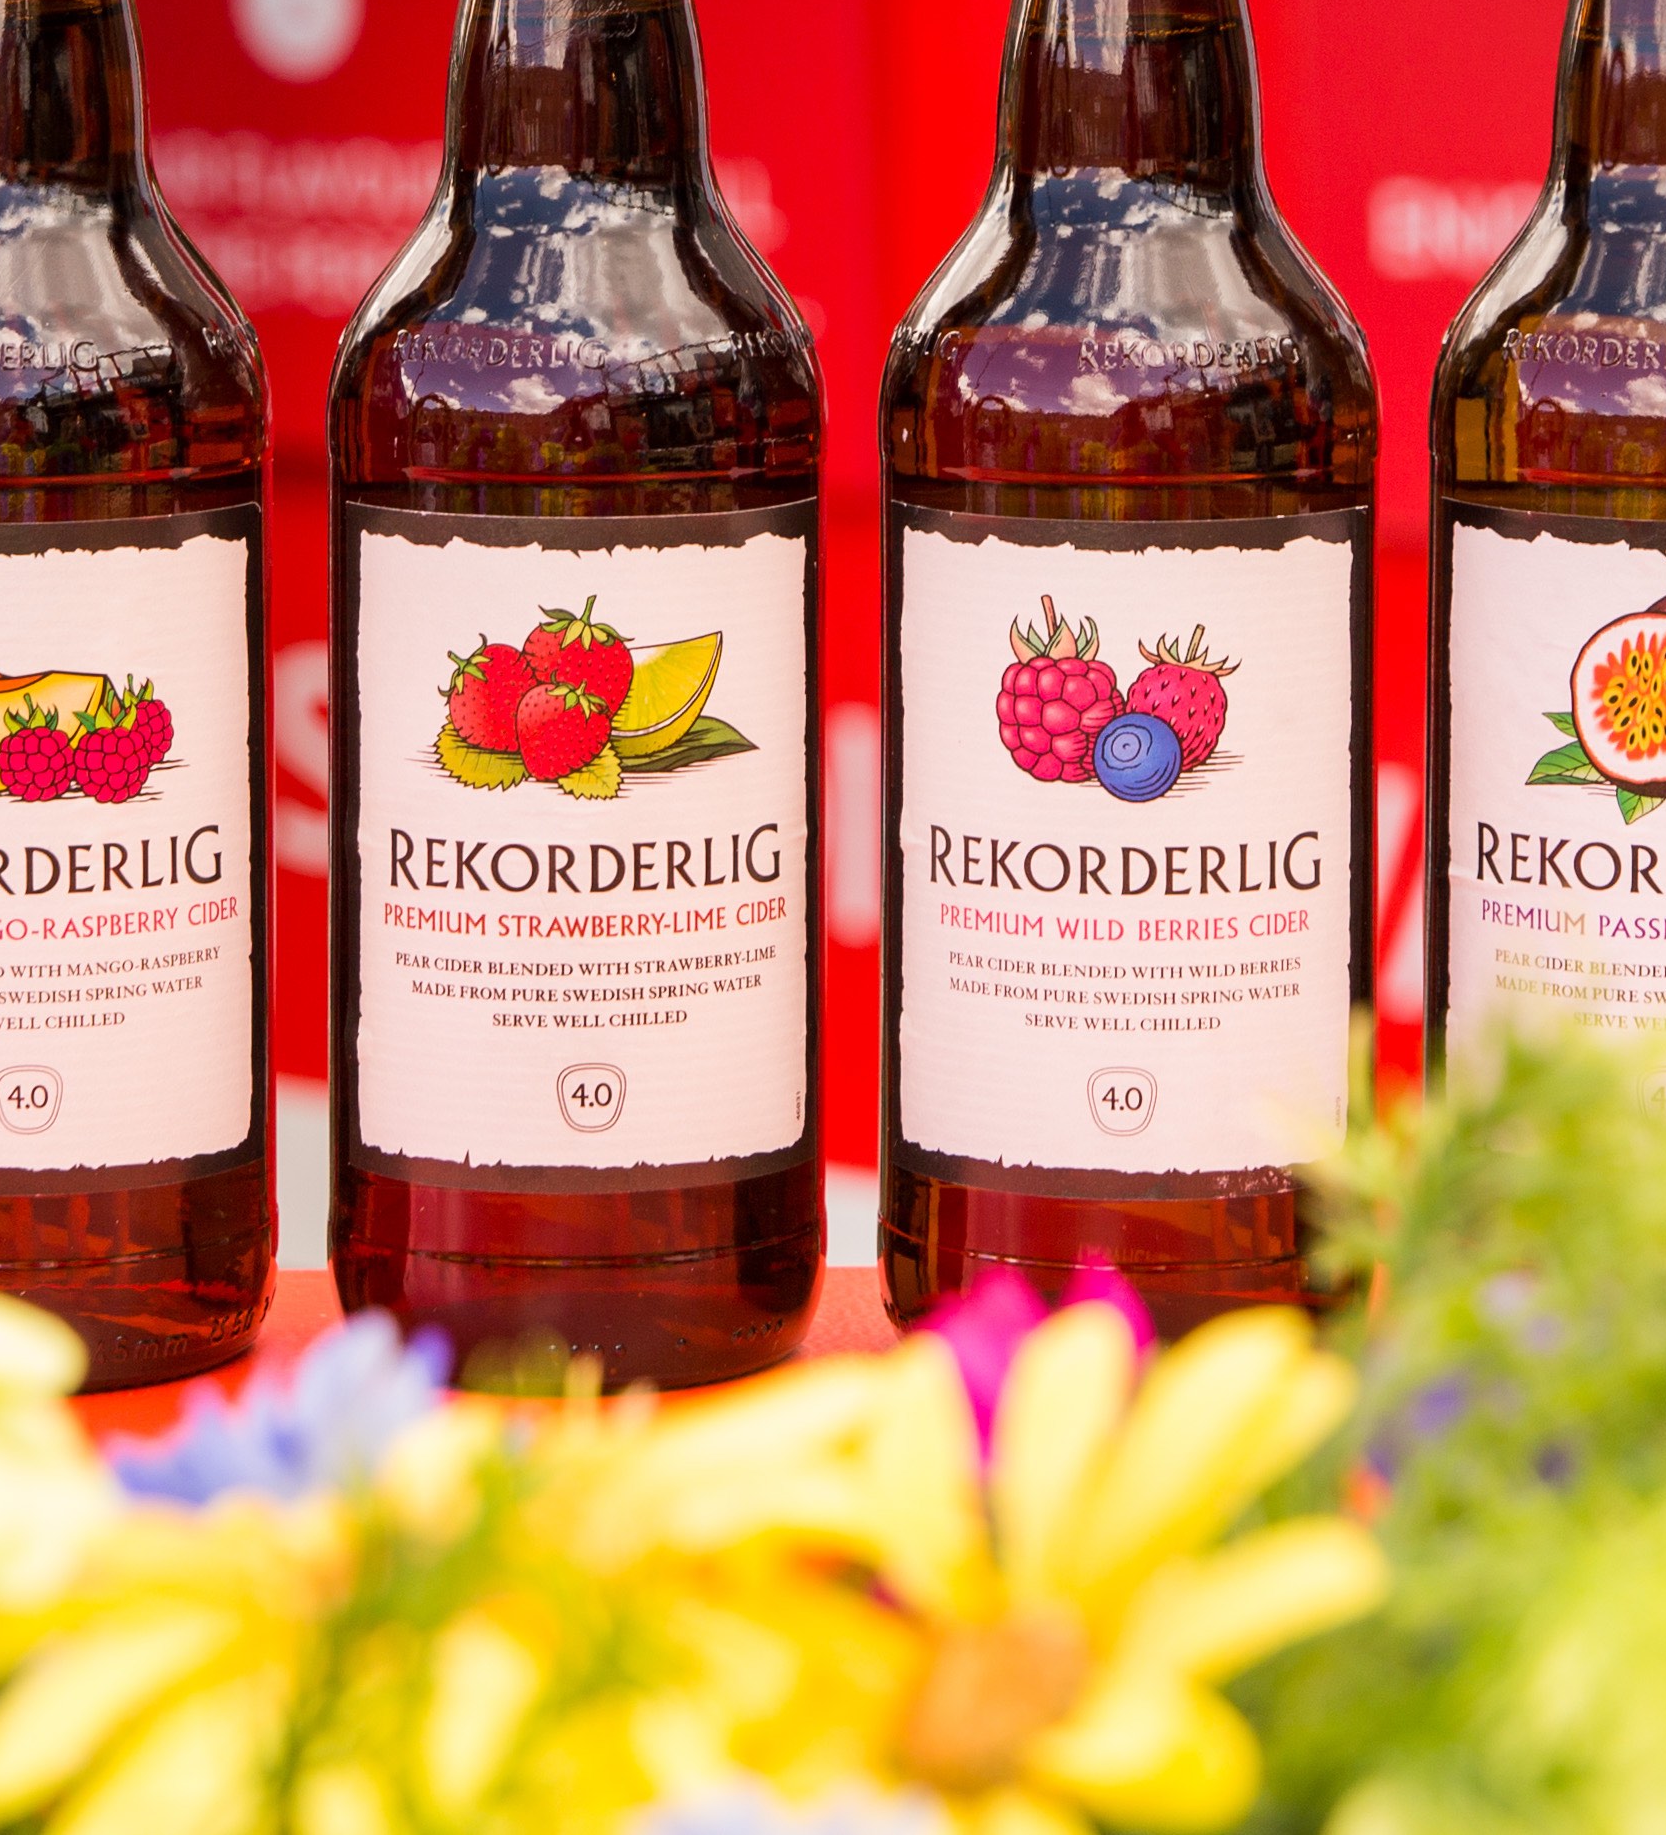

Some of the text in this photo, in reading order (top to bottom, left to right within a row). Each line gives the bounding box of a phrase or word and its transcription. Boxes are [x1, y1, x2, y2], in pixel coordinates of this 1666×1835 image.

[392, 328, 607, 371] REKORDERLIG
[1076, 334, 1302, 372] REKORDERLIG
[390, 822, 781, 894] REKORDERLIG
[930, 824, 1321, 896] REKORDERLIG
[187, 896, 239, 927] CIDER
[384, 896, 787, 939] PREMIUM STRAWBERRY-LIME CIDER
[940, 902, 1310, 942] PREMIUM WILD BERRIES CIDER
[1481, 898, 1586, 936] PREMIUM
[10, 964, 62, 979] WITH
[67, 945, 221, 977] MANGO-RASPBERRY
[395, 944, 777, 977] PEAR CIDER BLENDED WITH STRAWBERRY-LIME
[949, 950, 1301, 980] PEAR CIDER BLENDED WITH WILD BERRIES
[1495, 948, 1532, 968] PEAR
[1534, 955, 1585, 974] CIDER
[85, 984, 148, 1001] SPRING
[151, 975, 203, 995] WATER
[411, 974, 762, 1003] MADE FROM PURE SWEDISH SPRING WATER
[950, 977, 1300, 1006] MADE FROM PURE SWEDISH SPRING WATER
[1495, 974, 1539, 996] MADE
[1541, 981, 1589, 1001] FROM
[1592, 986, 1639, 1003] PURE
[44, 1012, 126, 1029] CHILLED
[492, 1010, 688, 1028] SERVE WELL CHILLED
[1026, 1015, 1221, 1032] SERVE WELL CHILLED
[7, 1084, 49, 1110] 4.0
[570, 1082, 613, 1108] 4.0
[1101, 1086, 1143, 1112] 4.0
